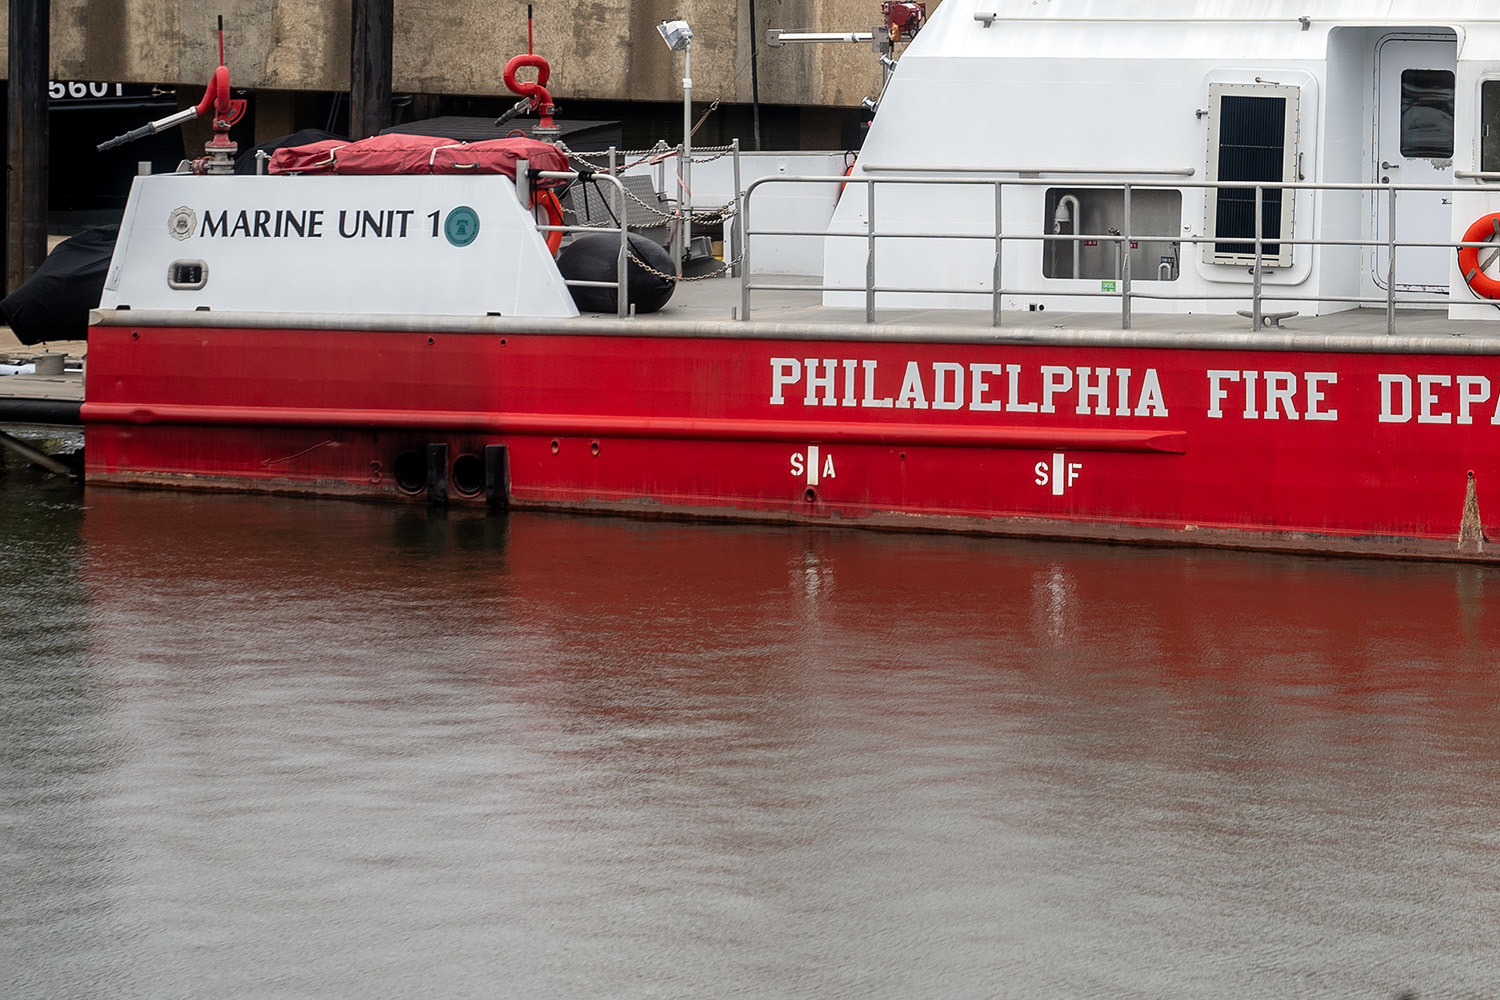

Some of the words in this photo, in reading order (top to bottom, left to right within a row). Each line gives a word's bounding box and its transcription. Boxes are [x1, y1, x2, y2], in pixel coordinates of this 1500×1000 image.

[199, 209, 325, 239] MARINE
[338, 209, 415, 240] UNIT
[427, 209, 441, 238] 1
[769, 357, 1170, 417] PHILADELPHIA
[1206, 369, 1338, 422] FIRE
